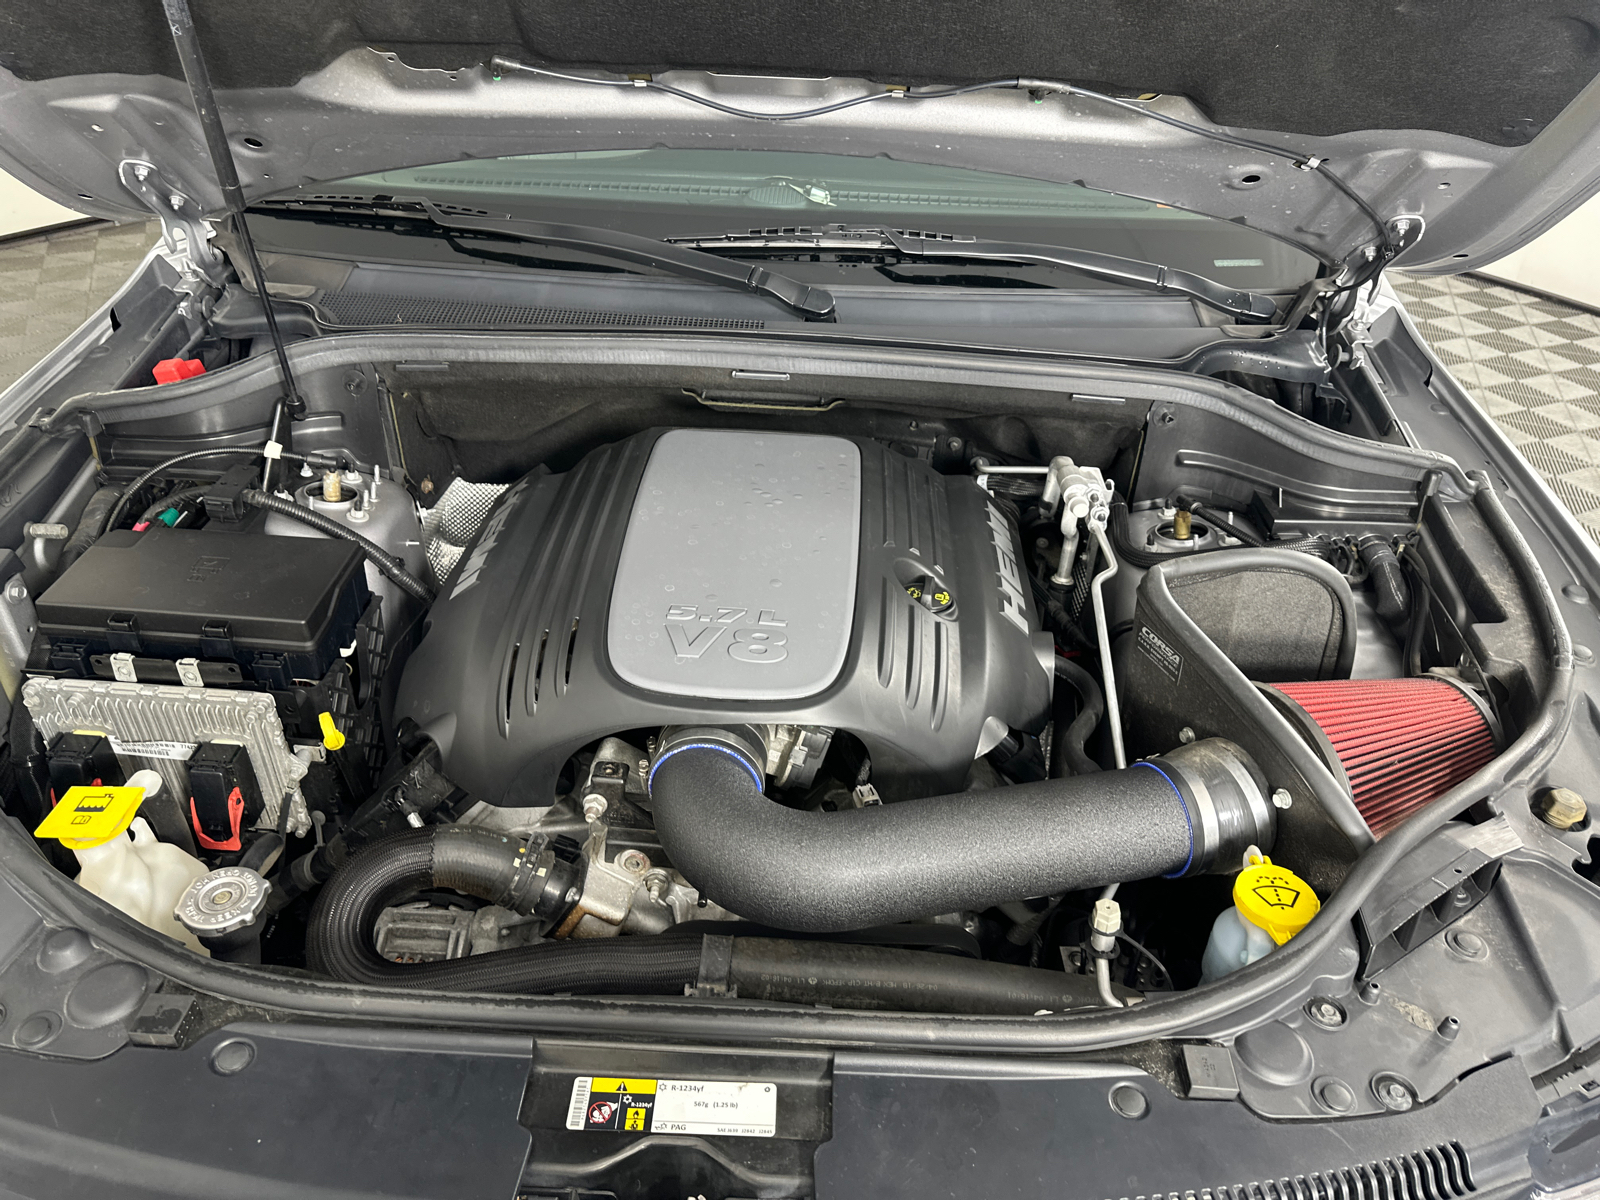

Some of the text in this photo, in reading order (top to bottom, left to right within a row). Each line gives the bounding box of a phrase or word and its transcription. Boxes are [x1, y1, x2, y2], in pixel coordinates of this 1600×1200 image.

[449, 477, 529, 600] HEMI
[985, 500, 1029, 637] HEMI
[663, 623, 789, 664] V8
[1141, 626, 1180, 665] CORSA
[211, 869, 240, 881] OPEN
[191, 878, 210, 894] HOT
[210, 907, 241, 923] KEEP
[671, 1084, 704, 1093] R-1234yf
[712, 1101, 729, 1109] (1.25
